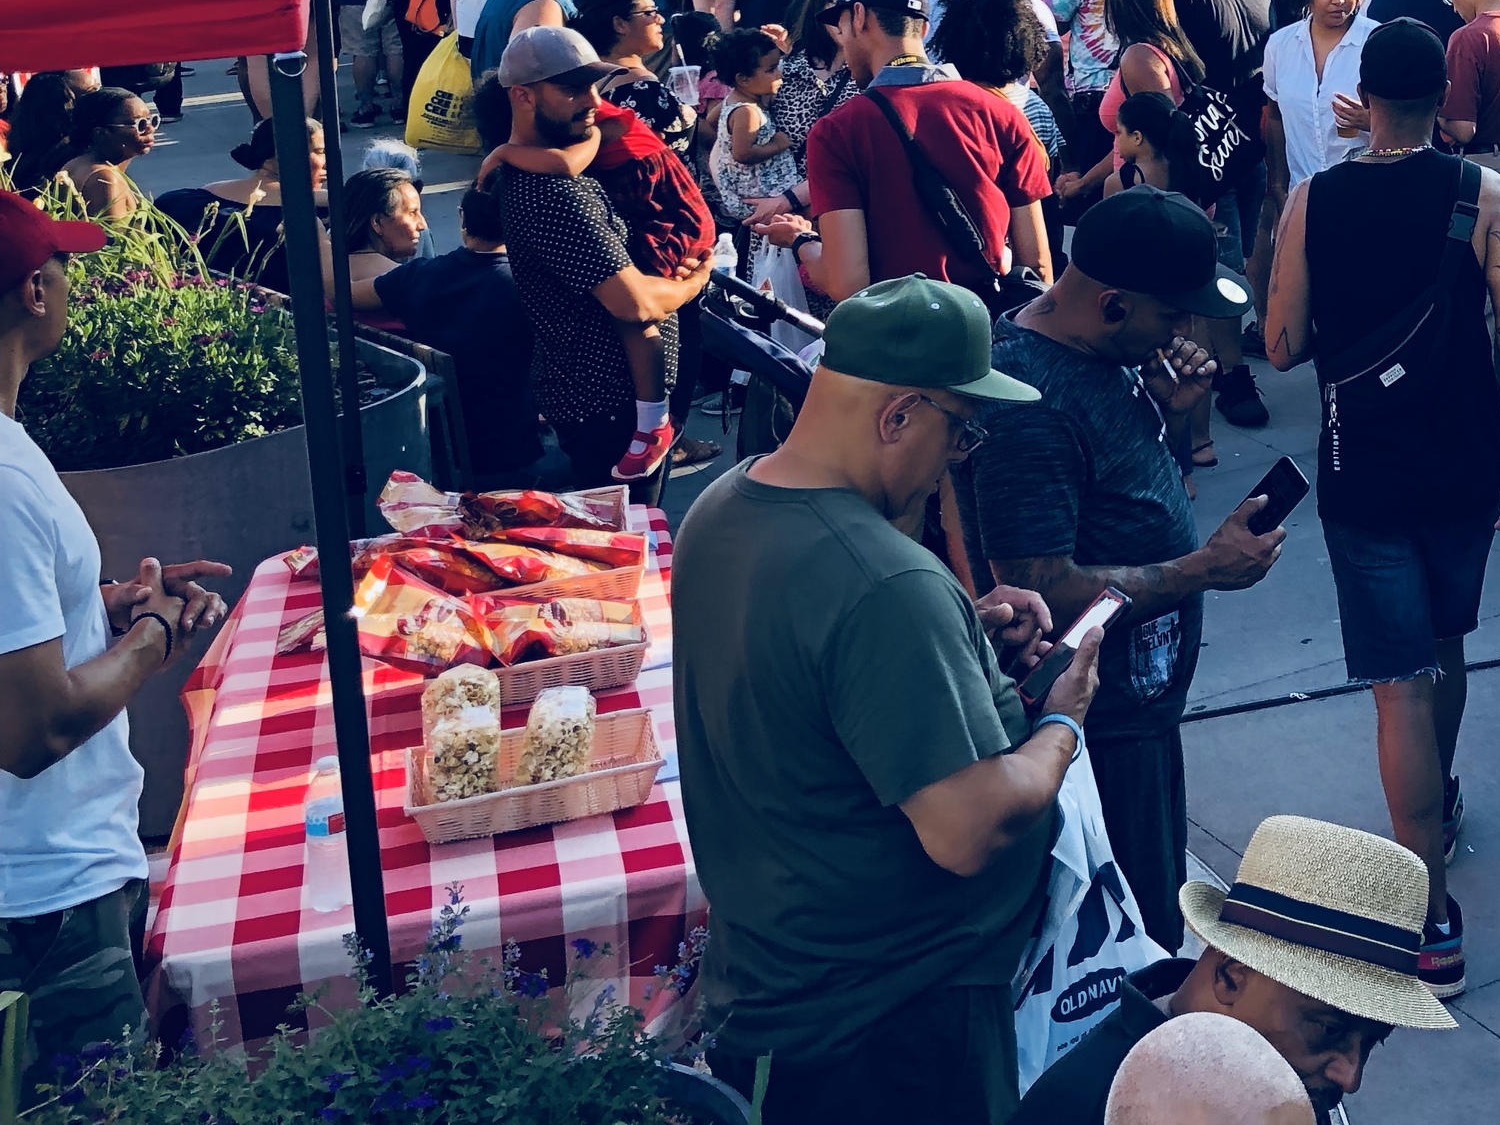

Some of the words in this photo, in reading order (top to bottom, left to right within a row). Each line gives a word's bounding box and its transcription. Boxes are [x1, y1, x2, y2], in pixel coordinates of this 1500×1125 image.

[891, 56, 918, 67] Nikon
[1198, 113, 1251, 182] Secret
[1060, 990, 1088, 1016] OLD
